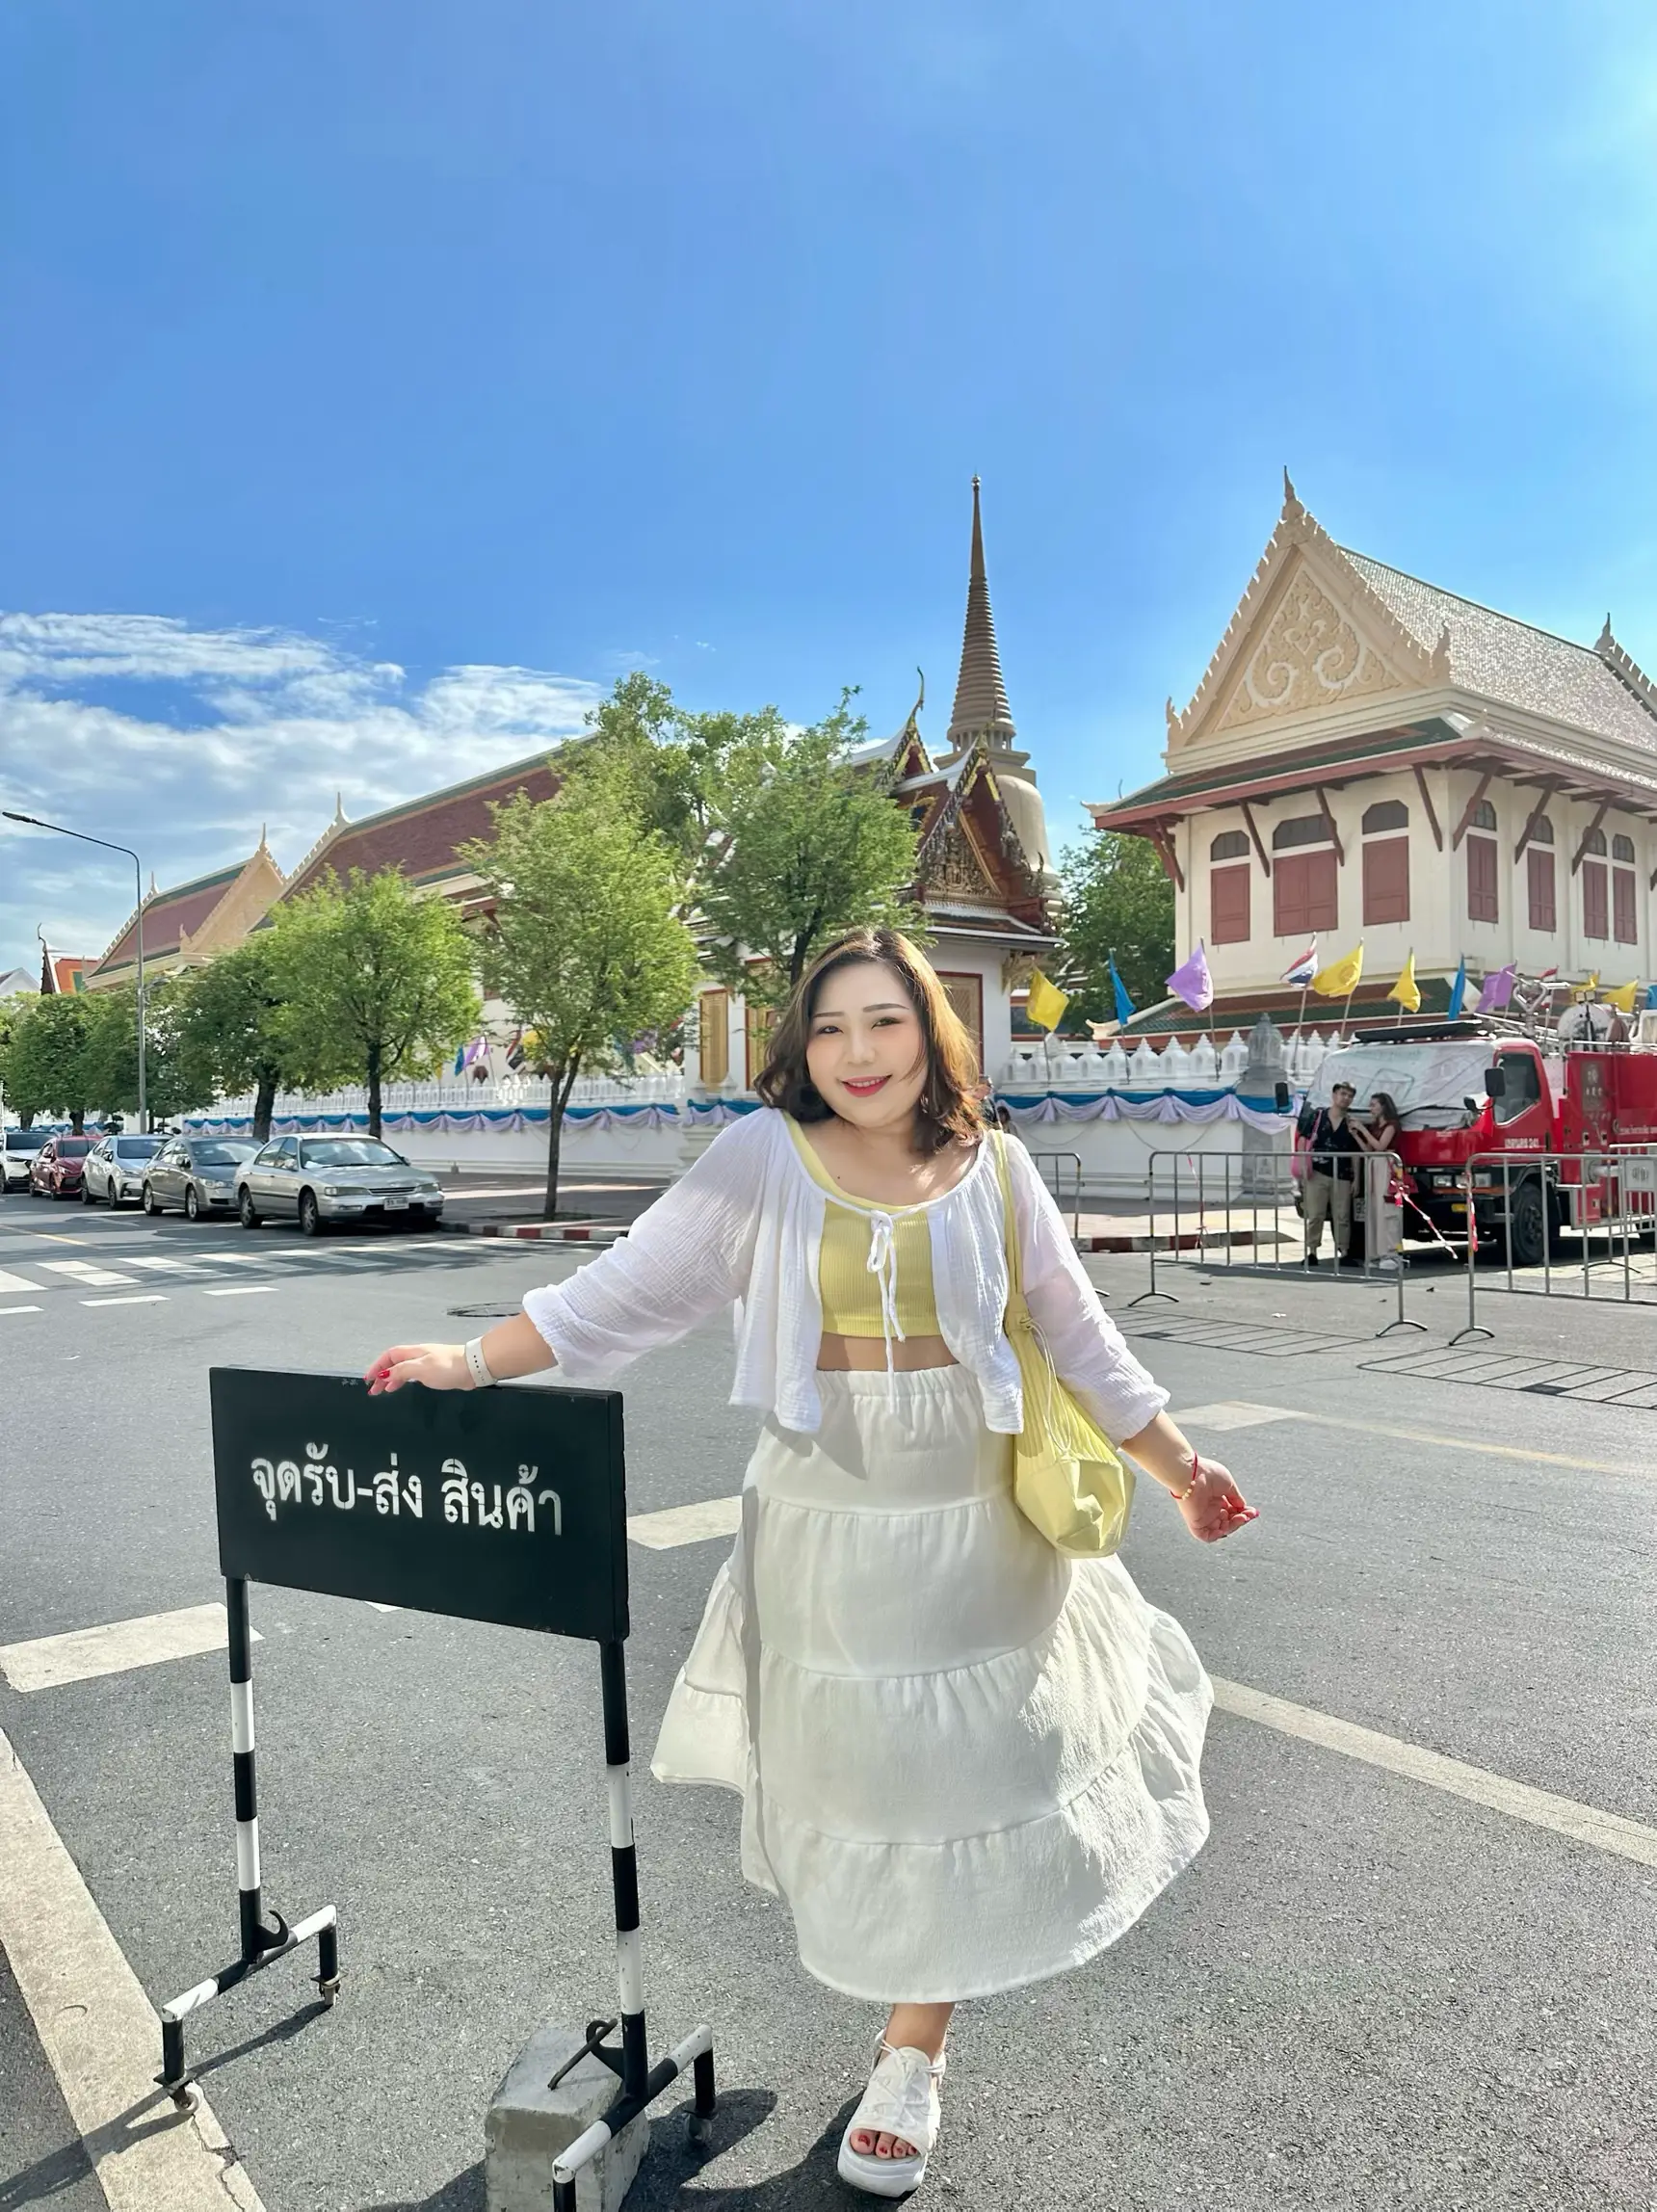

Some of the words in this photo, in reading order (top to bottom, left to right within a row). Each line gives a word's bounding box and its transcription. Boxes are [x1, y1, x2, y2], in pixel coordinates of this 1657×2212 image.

[250, 1442, 423, 1521] จุดรับ-ส่ง
[440, 1458, 562, 1536] สินค้า
